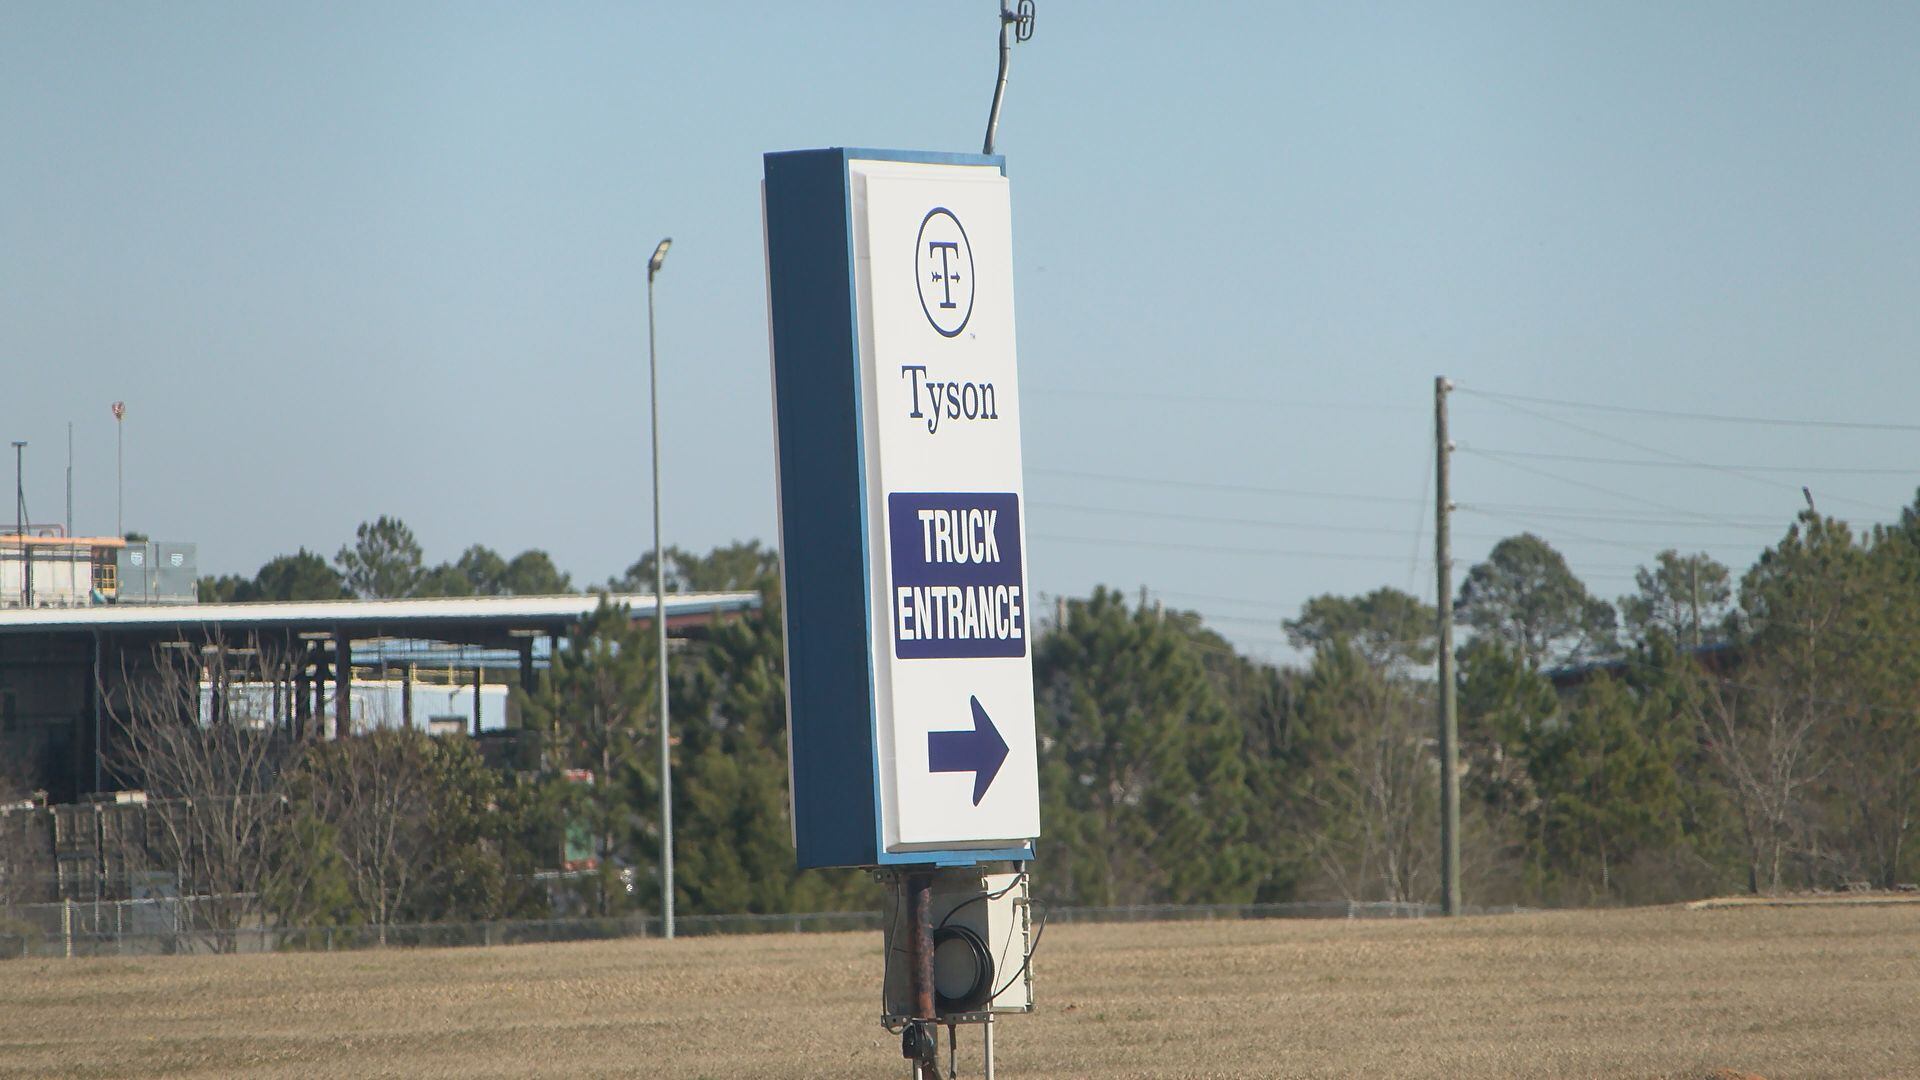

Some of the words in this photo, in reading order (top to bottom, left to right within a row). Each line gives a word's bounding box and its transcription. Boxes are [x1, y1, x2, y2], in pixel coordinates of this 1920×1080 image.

[929, 241, 959, 309] T
[901, 365, 998, 435] Tyson
[918, 508, 1000, 564] TRUCK
[897, 584, 1022, 640] ENTRANCE
